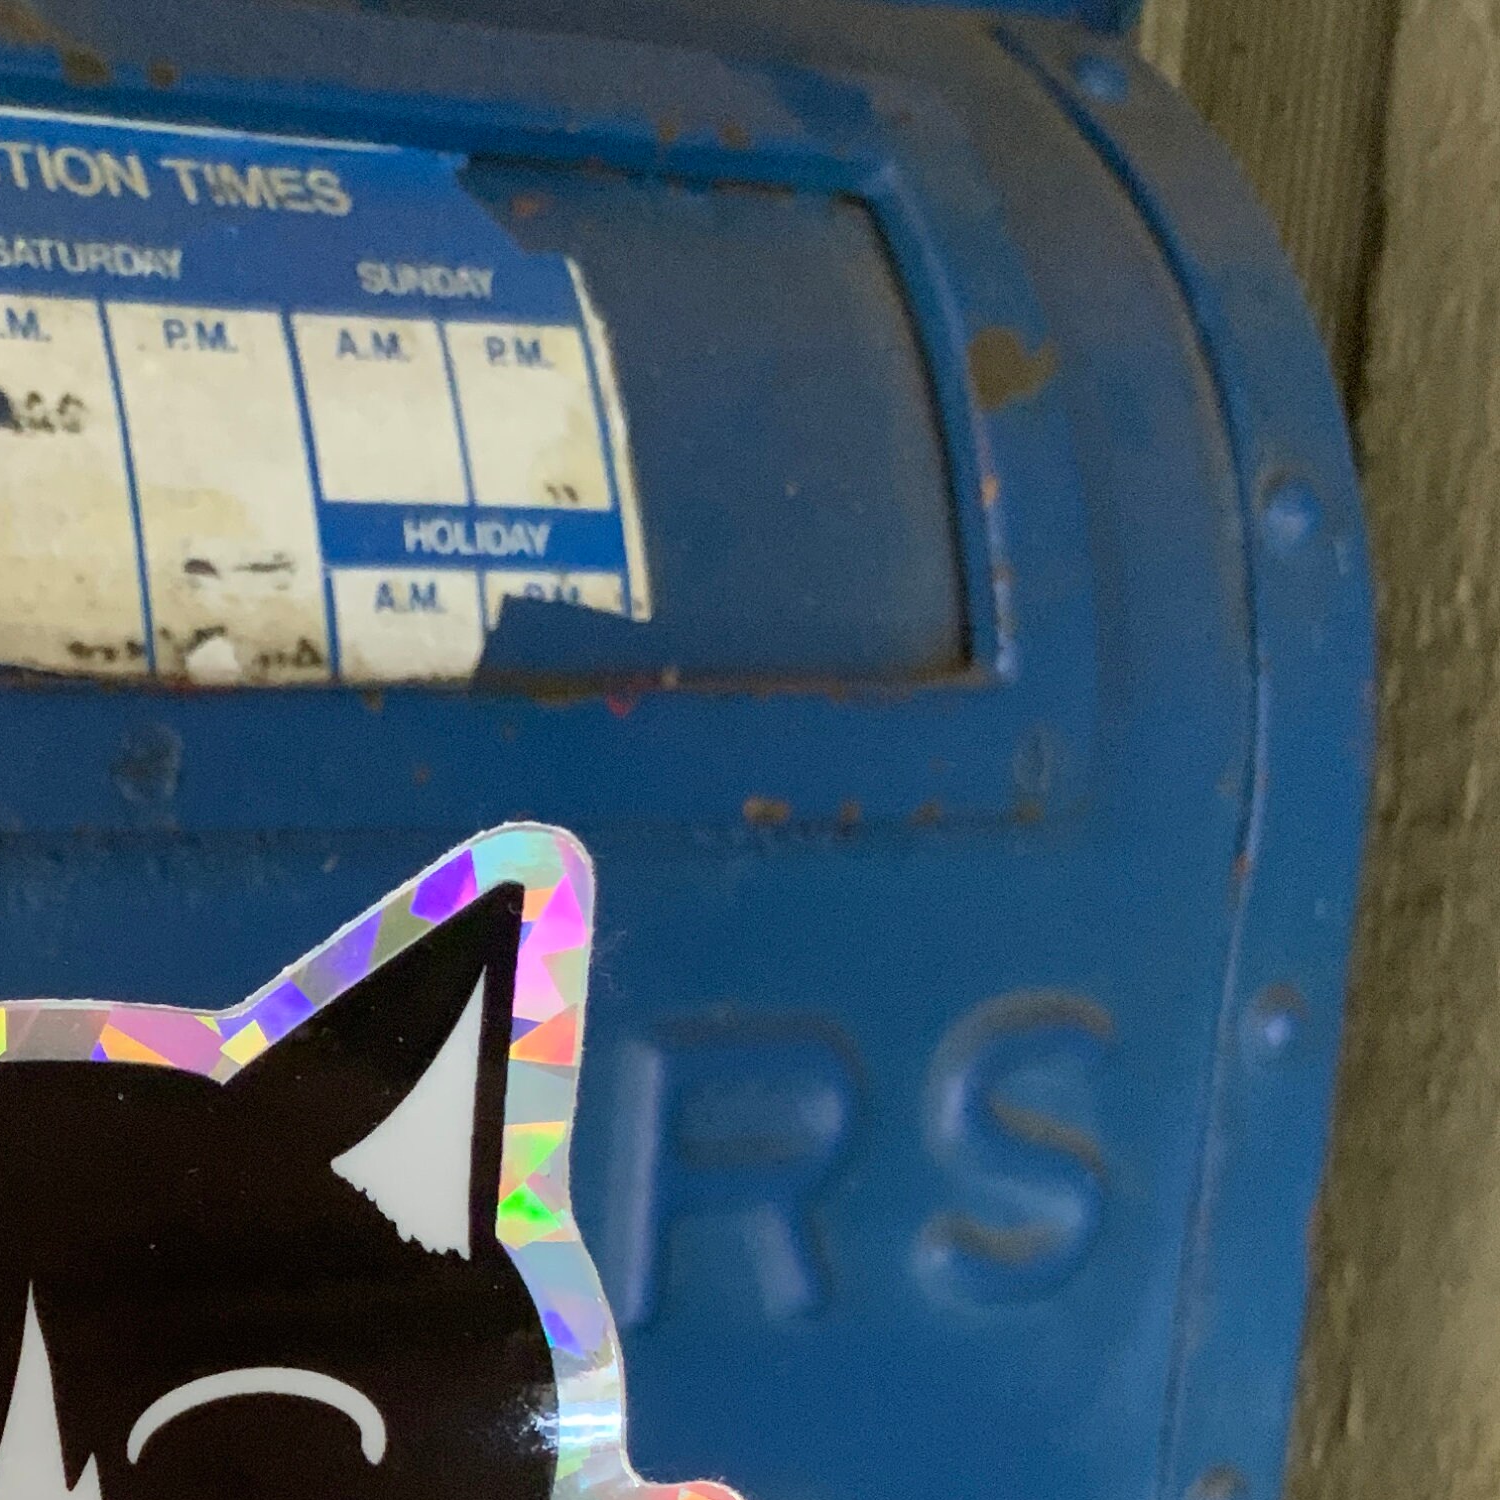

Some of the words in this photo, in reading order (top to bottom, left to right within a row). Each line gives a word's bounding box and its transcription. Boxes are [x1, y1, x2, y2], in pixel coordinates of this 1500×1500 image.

[159, 156, 353, 217] TIMES
[355, 260, 495, 300] SUNDAY
[162, 318, 239, 354] P.M.
[335, 328, 412, 363] A.M.
[484, 334, 555, 370] P.M.
[402, 518, 552, 558] HOLIDAY
